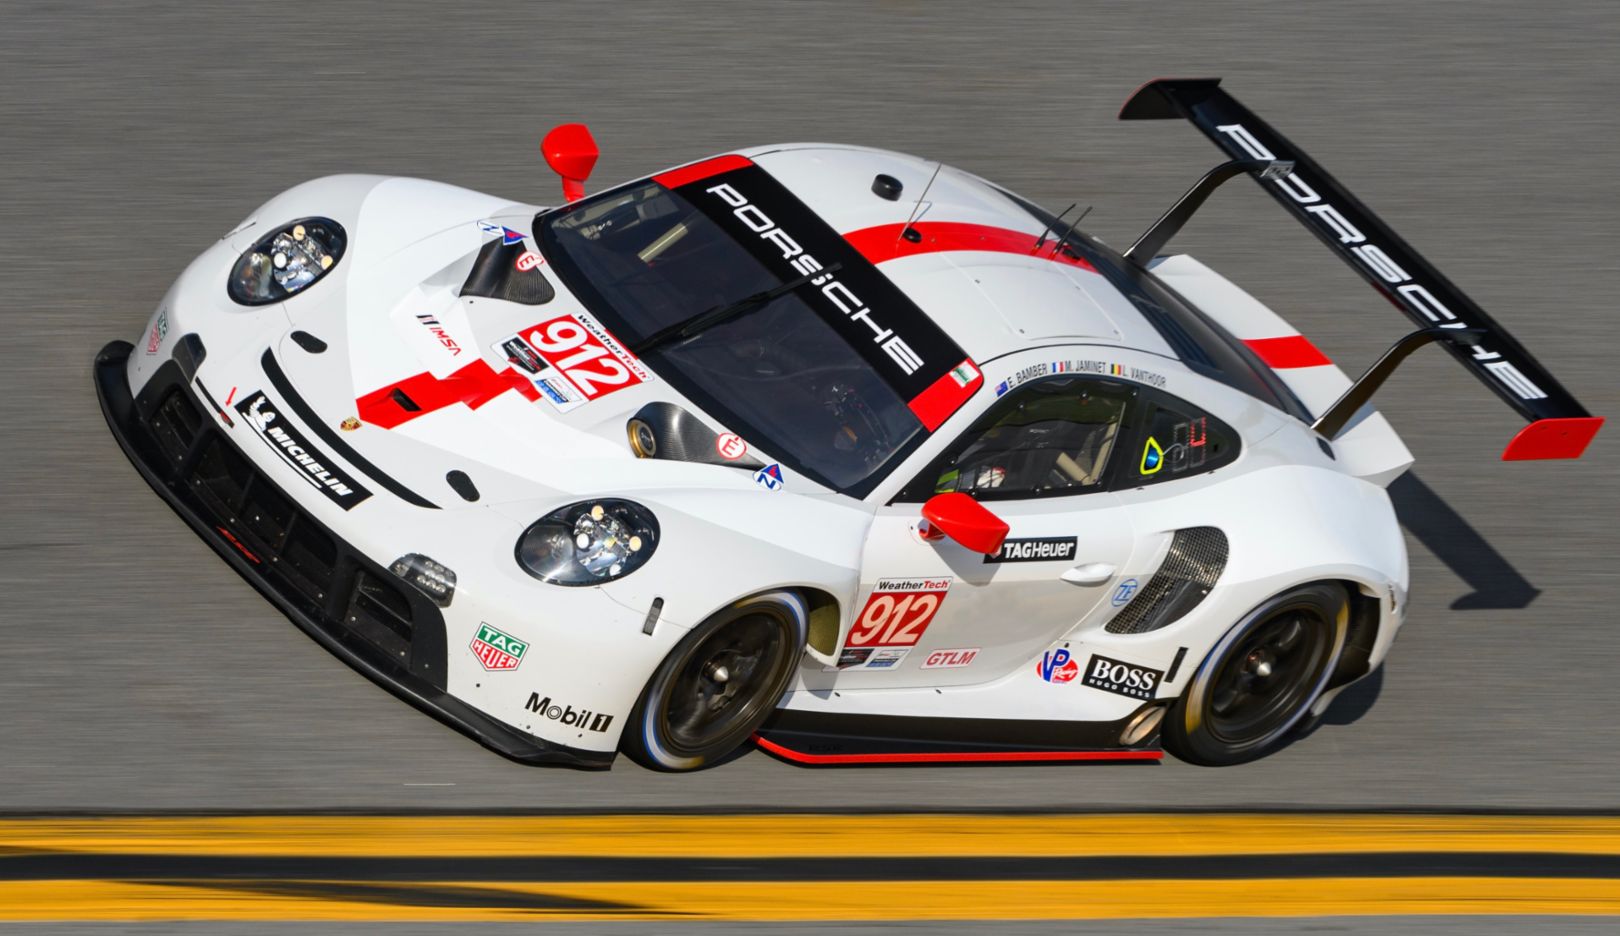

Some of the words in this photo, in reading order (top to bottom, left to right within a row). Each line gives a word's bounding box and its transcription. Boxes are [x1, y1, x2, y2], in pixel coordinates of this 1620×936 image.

[706, 183, 925, 376] PORSCHE
[429, 327, 461, 356] IMSA
[578, 315, 649, 379] WeatherTech
[530, 321, 631, 396] 912
[1007, 376, 1016, 388] E.
[1016, 363, 1047, 383] BAMBER
[1075, 361, 1106, 373] JAMINET
[1131, 367, 1166, 388] VANTHOOR
[267, 426, 353, 496] MICHELIN
[878, 580, 948, 590] WeatherTech
[1114, 584, 1137, 601] ZF
[851, 594, 938, 645] 912
[474, 640, 517, 667] HEUER
[483, 627, 523, 656] TAG
[926, 651, 976, 666] GTLM
[1043, 649, 1070, 682] VP
[1089, 678, 1117, 690] HUGO
[1123, 687, 1150, 698] BOSS
[1091, 660, 1156, 690] BOSS
[525, 692, 592, 728] Mobil
